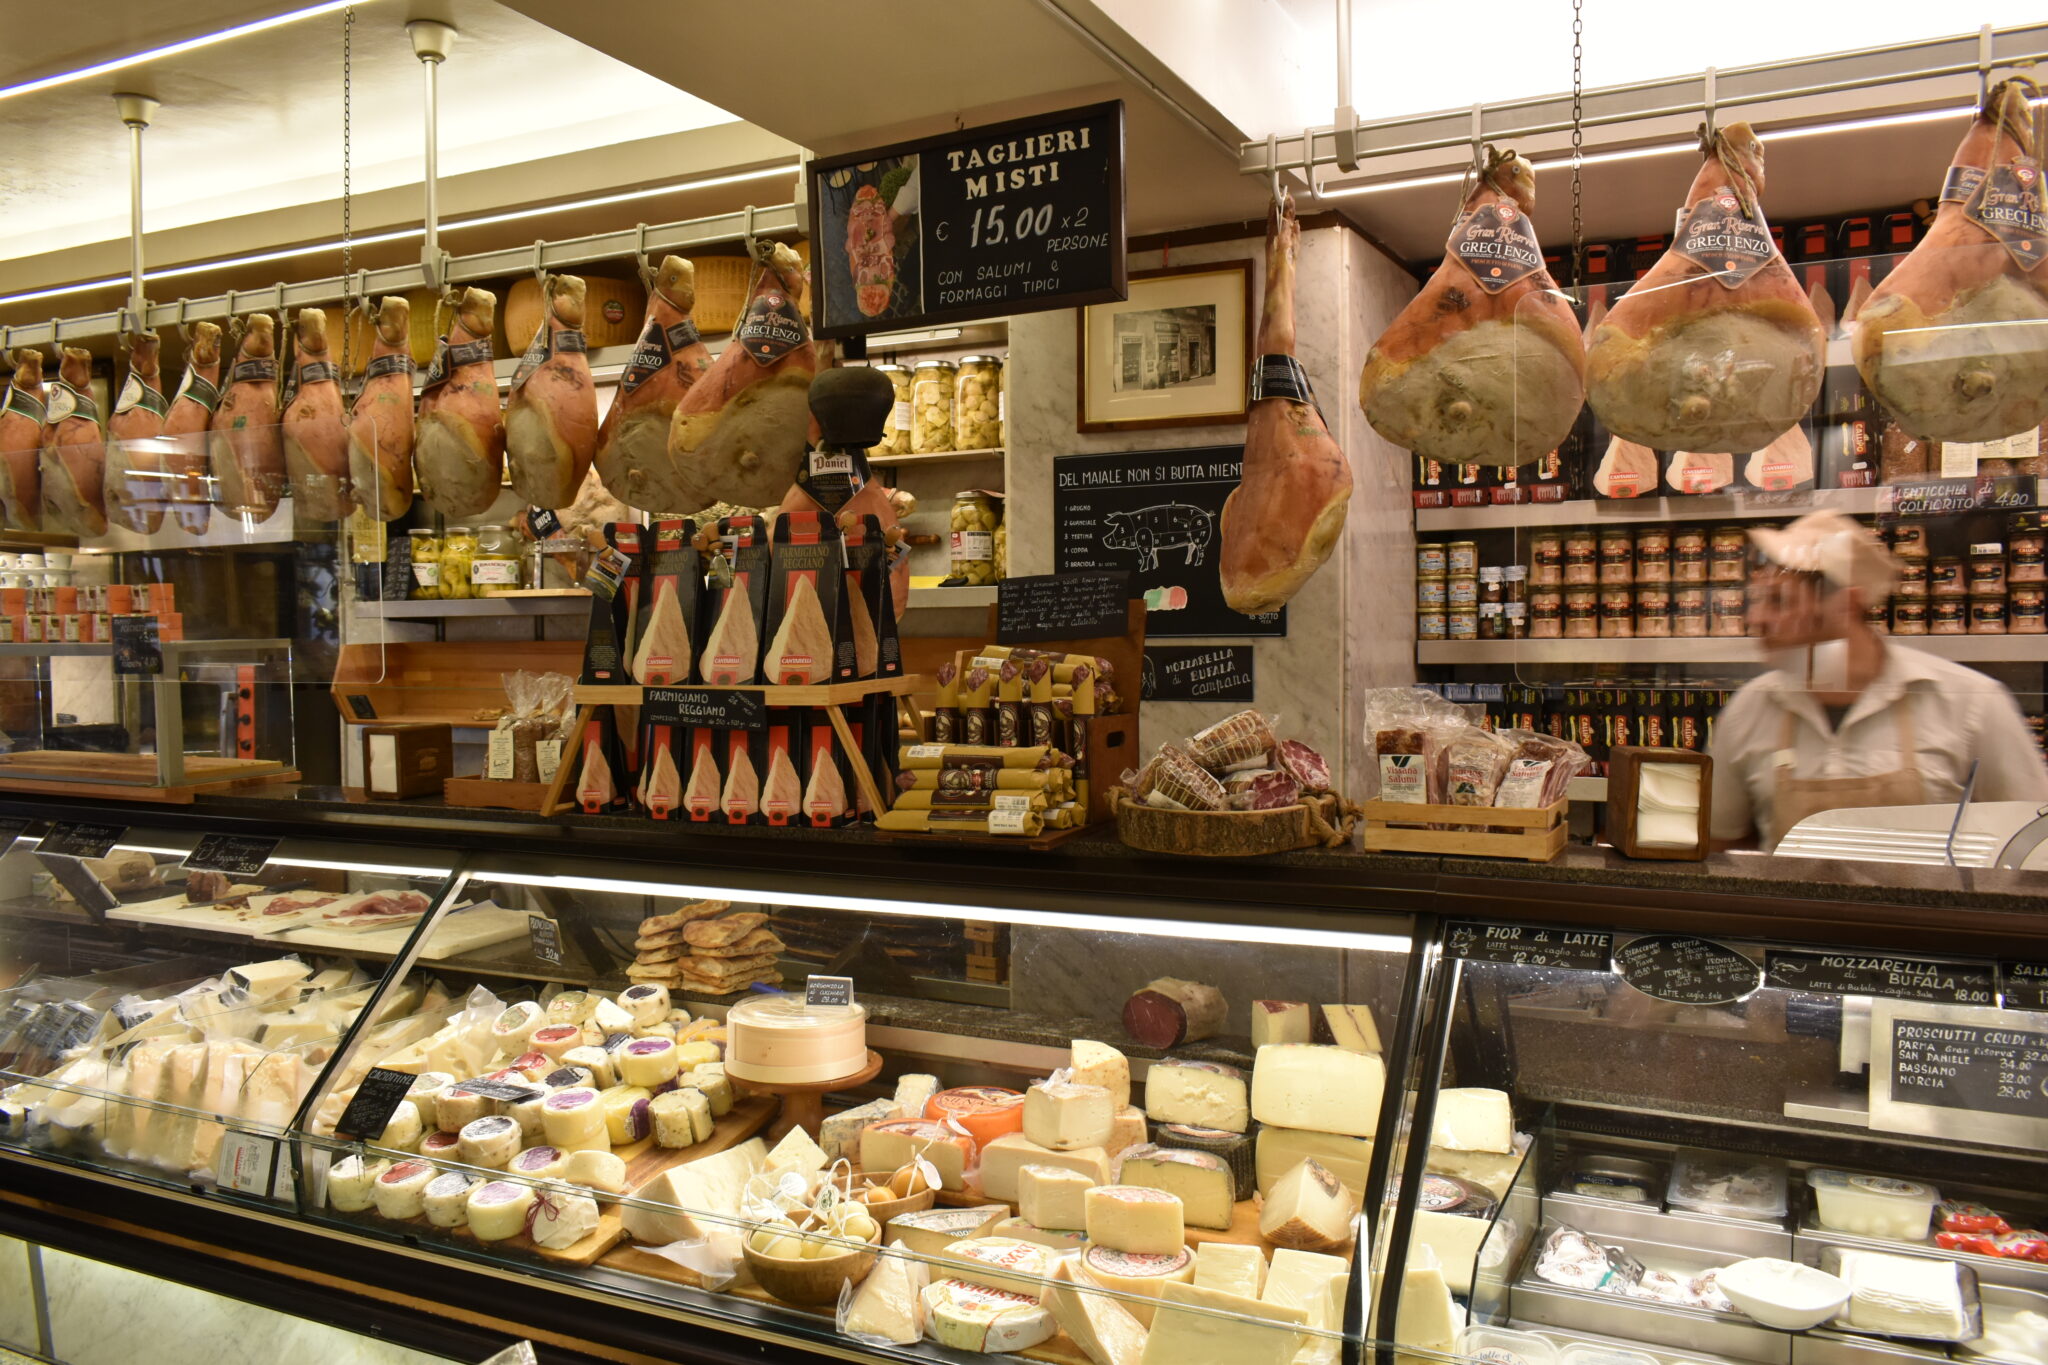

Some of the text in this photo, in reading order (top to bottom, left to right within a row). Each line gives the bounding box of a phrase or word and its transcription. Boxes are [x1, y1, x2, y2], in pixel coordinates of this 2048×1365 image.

[948, 127, 1090, 172] TAGLIERI
[966, 162, 1059, 200] MISTI
[1988, 188, 2018, 205] Gran
[936, 221, 949, 241] €
[971, 204, 1053, 248] 15.00
[1689, 217, 1765, 238] Gran Riserva
[1982, 207, 2048, 231] GRECI EN
[1047, 232, 1108, 253] PERSONE
[1467, 225, 1535, 249] Gran Riserva
[1686, 235, 1769, 253] GRECI ENZO
[1460, 241, 1538, 265] GRECI ENZO
[937, 271, 962, 286] CON
[977, 262, 1032, 281] SALUMI
[940, 279, 1059, 304] FORMAGGI TIPICI
[746, 312, 798, 328] Gran Riserva
[741, 326, 800, 341] GRECI ENZO
[639, 354, 662, 366] ENZO
[1855, 424, 1864, 453] CALLIPO
[814, 457, 847, 471] Daniel
[1059, 462, 1243, 487] DEL MAIALE NON SI BUTTA NIENT
[1896, 482, 1994, 499] LENTICCHIA di
[1898, 498, 1974, 512] COLFIORITO
[534, 512, 552, 530] UNICO
[779, 548, 829, 558] PARMIGIANO
[783, 558, 824, 568] REGGIANO
[1070, 560, 1095, 568] BRACIOLA
[781, 657, 812, 665] CANTARELLI
[1165, 649, 1234, 674] MOZZARELLA
[1172, 661, 1235, 685] di BUFALA
[649, 690, 708, 704] PARMIGIANO
[679, 704, 726, 716] REGGIANO
[1581, 716, 1591, 745] CALLIPO
[1616, 716, 1626, 745] CALLIPO
[1650, 717, 1659, 746] CALLIPO
[1684, 719, 1694, 747] CALLIPO
[1486, 926, 1610, 947] FIOR di LATTE
[1511, 944, 1536, 952] vaccino
[1545, 947, 1570, 958] caglio
[1513, 952, 1546, 964] 12.00
[1821, 956, 1938, 976] MOZZARELLA
[1809, 981, 1832, 989] LATTE
[1885, 987, 1911, 997] caglio
[1844, 970, 1955, 989] di BUFALA
[1658, 989, 1679, 998] LATTE
[1954, 989, 1989, 1002] 18.00
[1897, 1026, 2027, 1045] PROSCIUTTI CRUDI
[1898, 1040, 1935, 1052] PARMA
[1945, 1046, 1970, 1055] Gran
[1898, 1050, 2032, 1071] SAN DANIELE 34.00
[1899, 1062, 2032, 1085] BASSIANO 32.00
[1900, 1076, 2032, 1100] NORCIA 28.00
